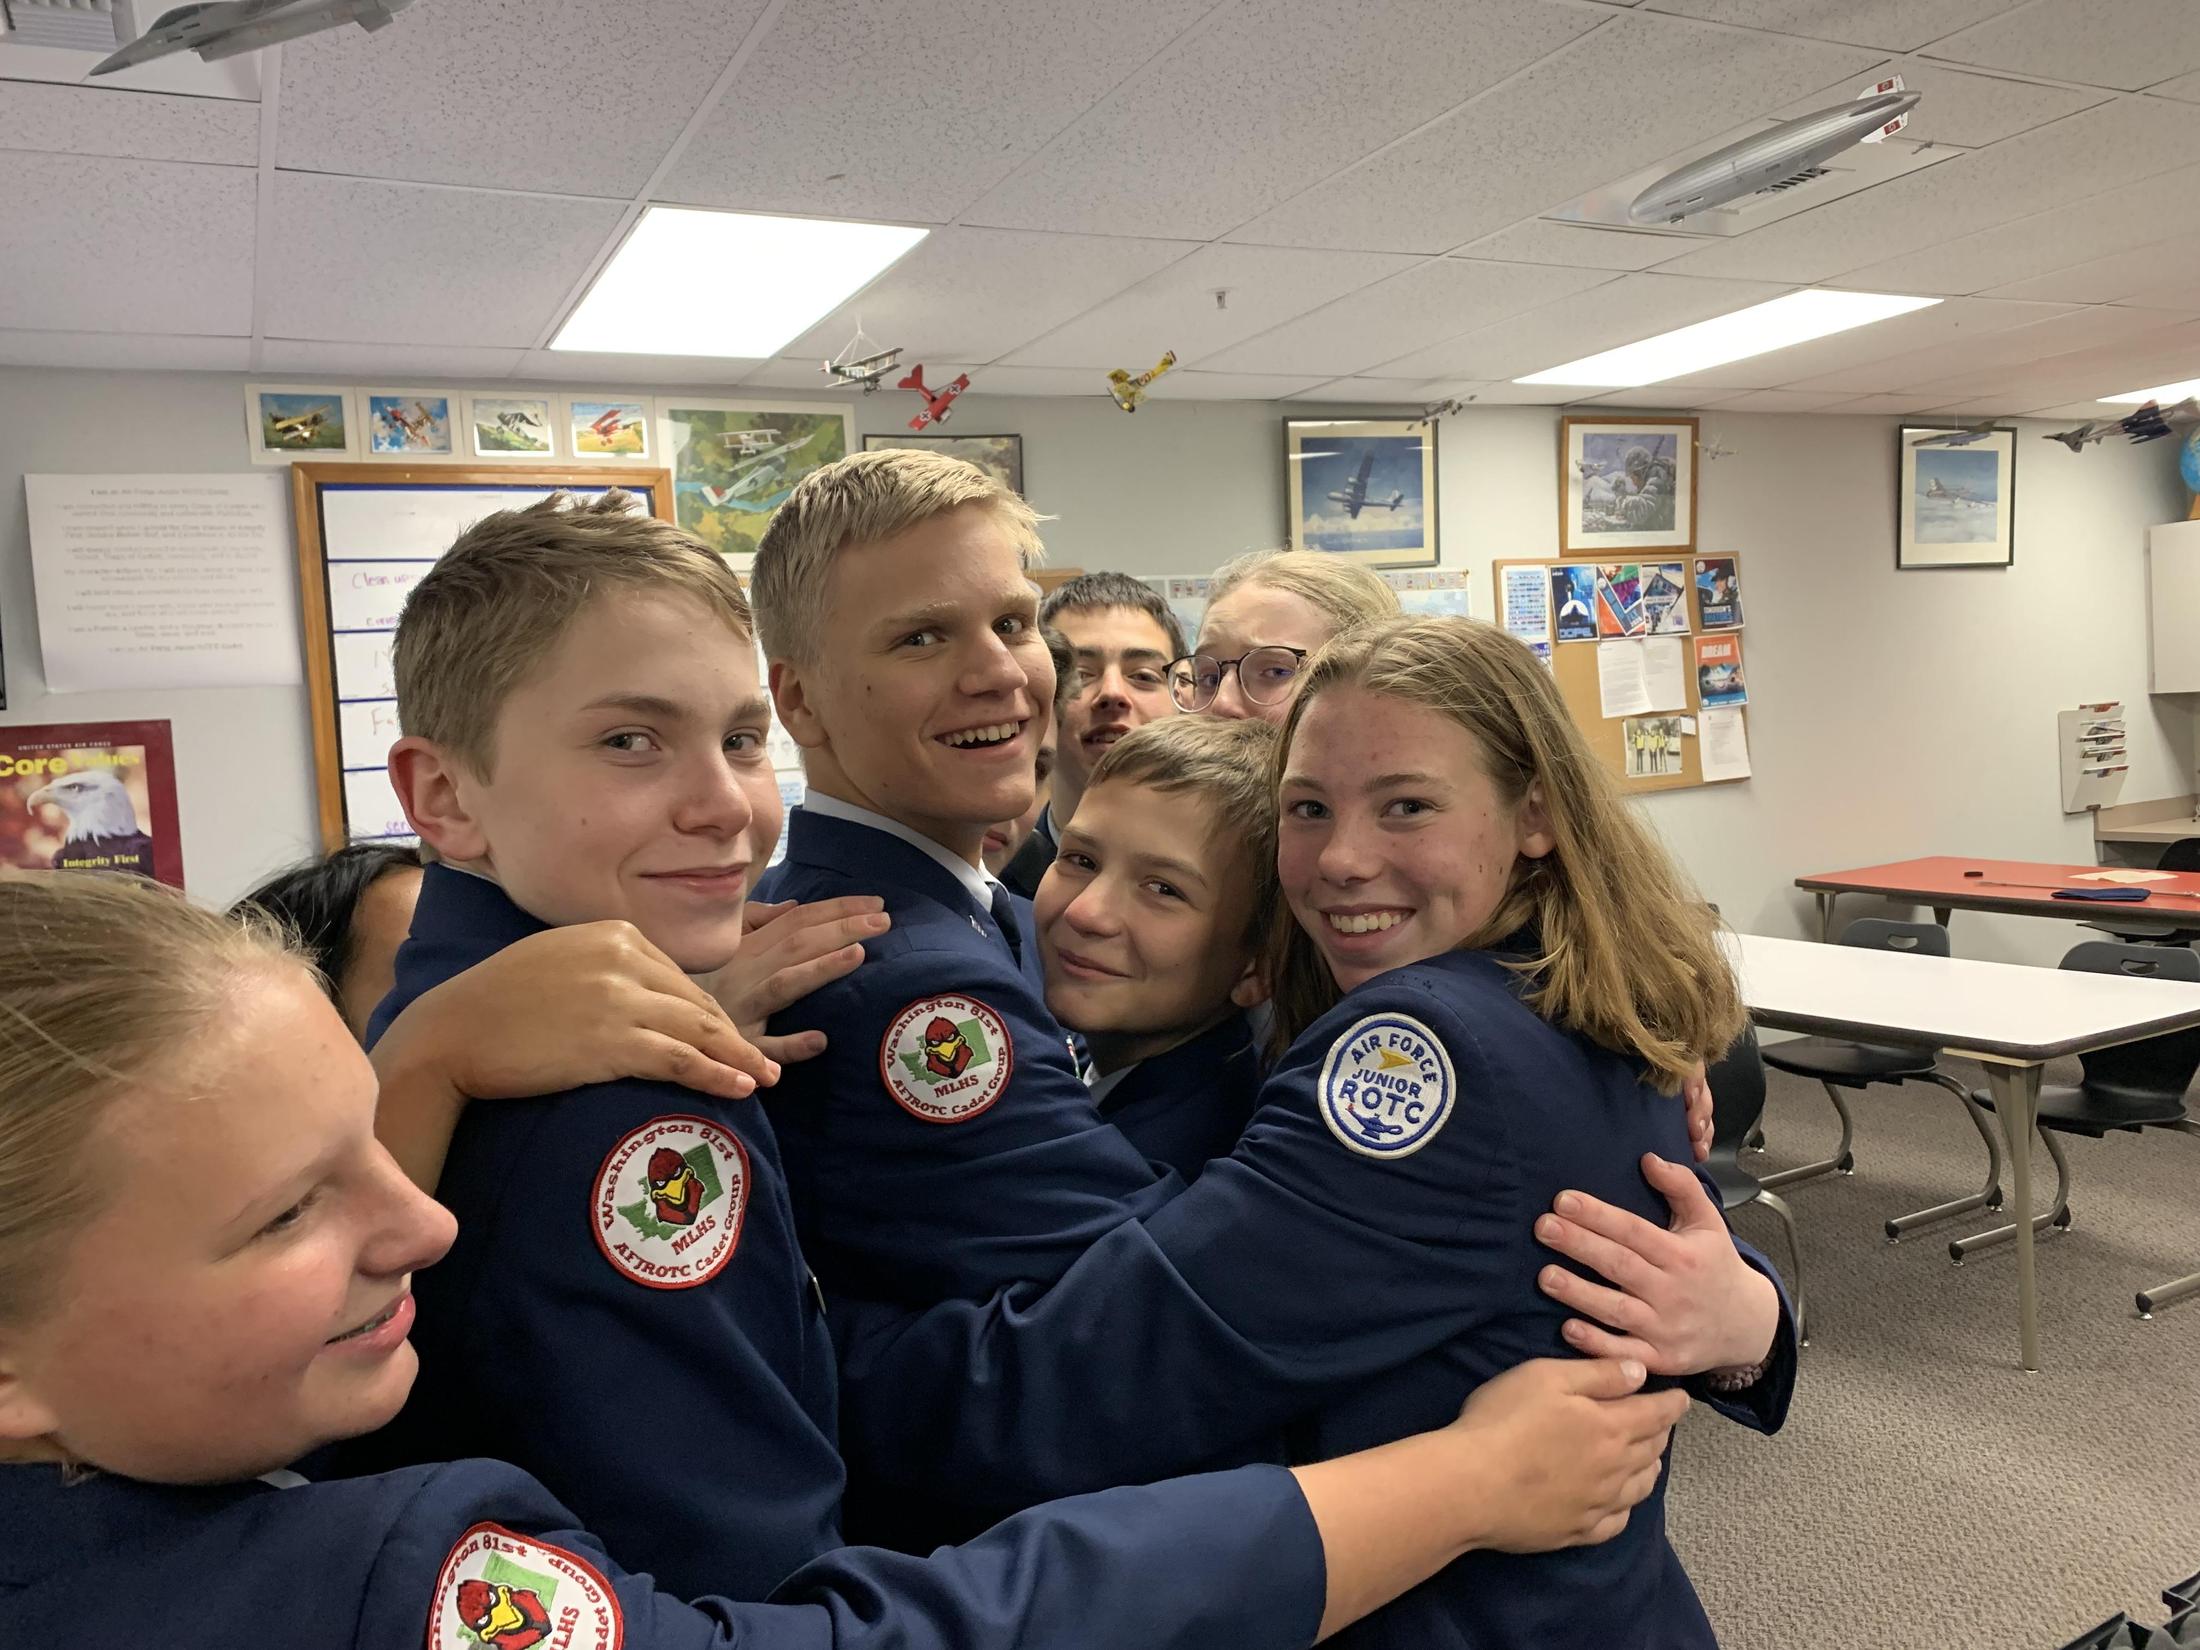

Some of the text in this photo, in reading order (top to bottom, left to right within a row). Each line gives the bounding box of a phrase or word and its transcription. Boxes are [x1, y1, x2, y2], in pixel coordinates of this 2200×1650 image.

[0, 751, 141, 777] Core Values
[63, 854, 139, 869] Integrity First
[886, 1000, 999, 1069] Washington 81st
[1351, 1033, 1437, 1084] AIR FORCE
[892, 1047, 1007, 1115] AFJROTC Cadet Group
[934, 1075, 979, 1098] MLHS
[1339, 1079, 1425, 1124] ROTC
[1352, 1069, 1422, 1098] JUNIOR
[602, 1124, 734, 1230] Washington 81st
[614, 1174, 741, 1278] AFJROTC Cadet Group
[671, 1215, 717, 1255] MLHS
[483, 1534, 528, 1558] 81st
[548, 1557, 610, 1650] adet Group
[549, 1606, 580, 1650] LHS
